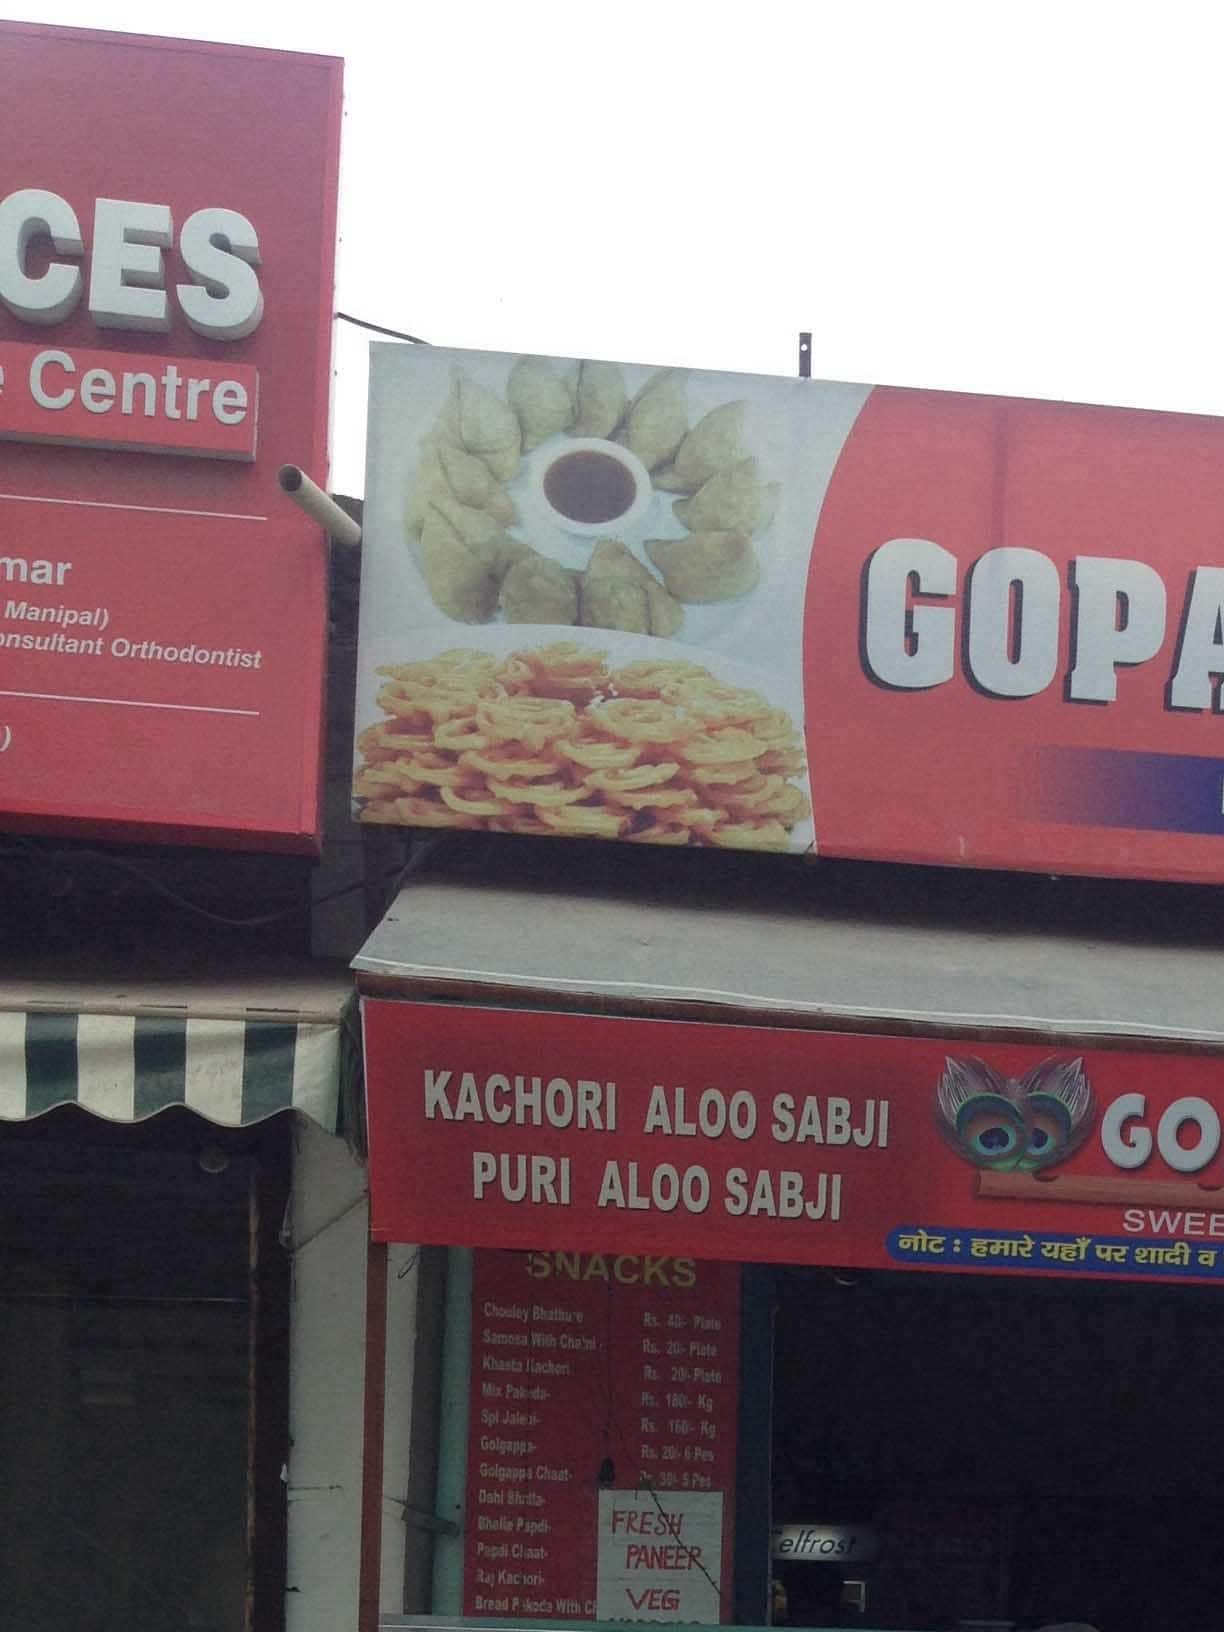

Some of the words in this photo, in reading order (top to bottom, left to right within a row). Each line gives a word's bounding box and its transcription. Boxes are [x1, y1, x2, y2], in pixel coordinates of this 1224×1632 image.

[0, 189, 264, 341] CES
[29, 350, 248, 424] Centre
[5, 600, 109, 631] Manipal)
[111, 638, 262, 669] Orthodontist
[423, 1069, 617, 1131] KACHORI
[644, 1086, 757, 1140] ALOO
[771, 1092, 890, 1149] SABJI
[473, 1151, 570, 1205] PURI
[598, 1160, 710, 1213] ALOO
[725, 1166, 842, 1221] SABJI
[898, 1230, 946, 1253] नोट
[971, 1235, 1035, 1259] हमारे
[1095, 1244, 1130, 1263] पर
[1135, 1242, 1191, 1267] शादी
[527, 1253, 698, 1287] SNACKS
[611, 1510, 685, 1536] FRESH
[626, 1543, 704, 1570] PANEER
[771, 1528, 857, 1554] elfrost
[624, 1588, 681, 1612] VEG
